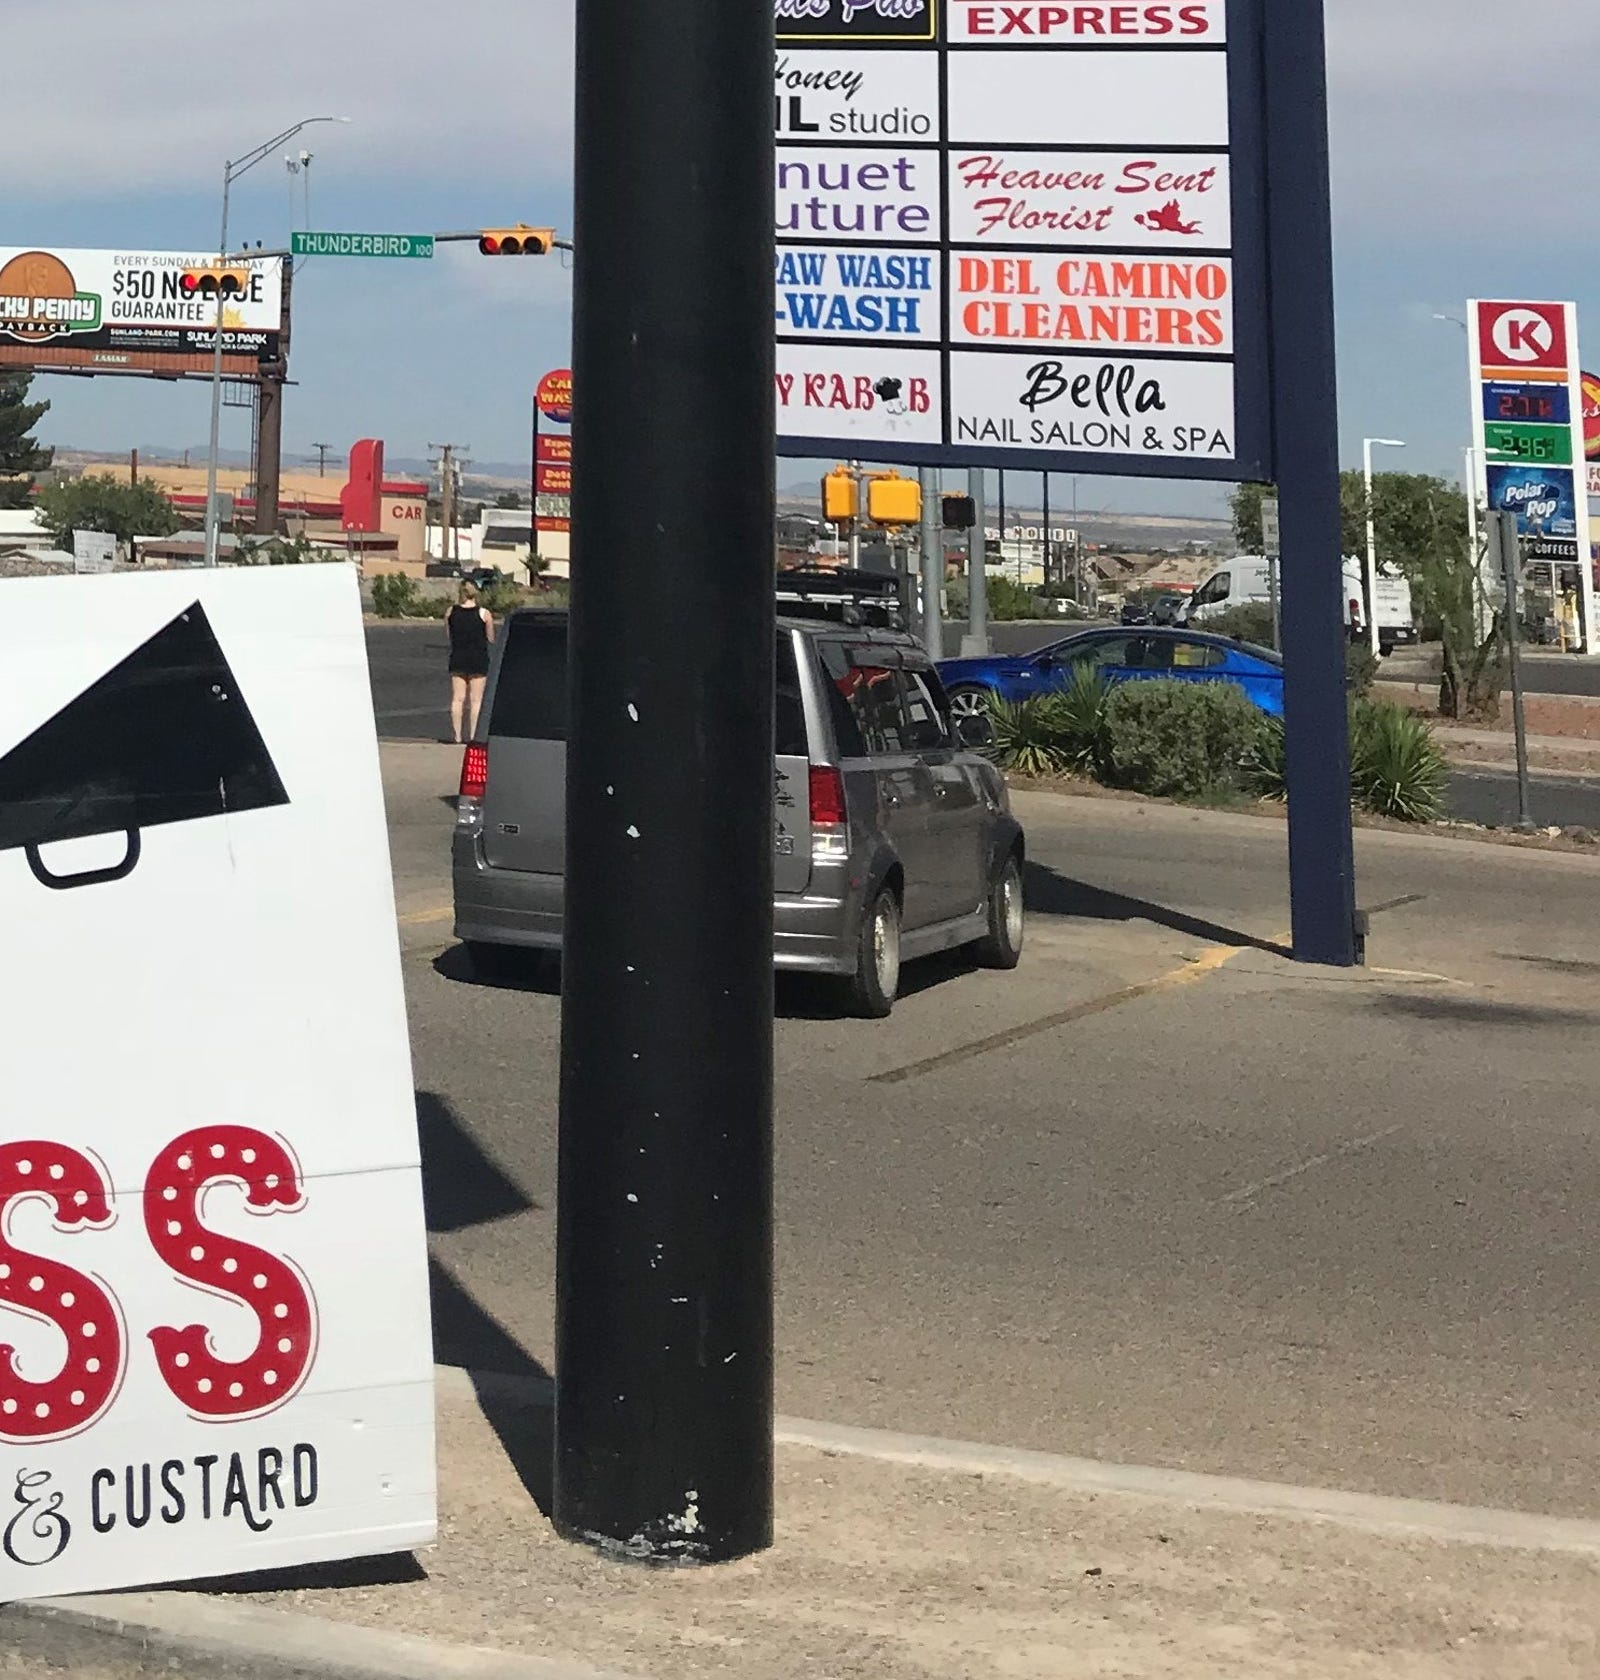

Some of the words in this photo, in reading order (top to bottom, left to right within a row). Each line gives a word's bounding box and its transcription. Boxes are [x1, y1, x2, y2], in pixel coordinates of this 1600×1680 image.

[967, 5, 1209, 35] EXPRESS
[829, 107, 931, 135] studio
[957, 155, 1106, 191] Heaven
[1114, 160, 1217, 193] Sent
[973, 196, 1115, 236] Florist
[113, 255, 149, 267] EVERY
[151, 256, 198, 268] SUNDAY
[201, 257, 209, 267] &
[297, 233, 411, 255] THUNDERBIRD
[415, 244, 432, 256] 100
[112, 270, 155, 299] $50
[836, 253, 932, 291] WASH
[958, 257, 1040, 295] DEL
[1056, 260, 1228, 302] CAMINO
[111, 300, 205, 321] GUARANTEE
[962, 300, 1225, 347] CLEANERS
[1020, 361, 1166, 419] Bella
[958, 417, 1022, 444] NAIL
[1030, 419, 1131, 450] SALON
[1142, 425, 1164, 450] &
[1173, 426, 1232, 455] SPA
[1506, 481, 1546, 502] Polar
[392, 505, 422, 520] CAR
[2, 1466, 73, 1567] &
[90, 1441, 319, 1533] CUSTARD
